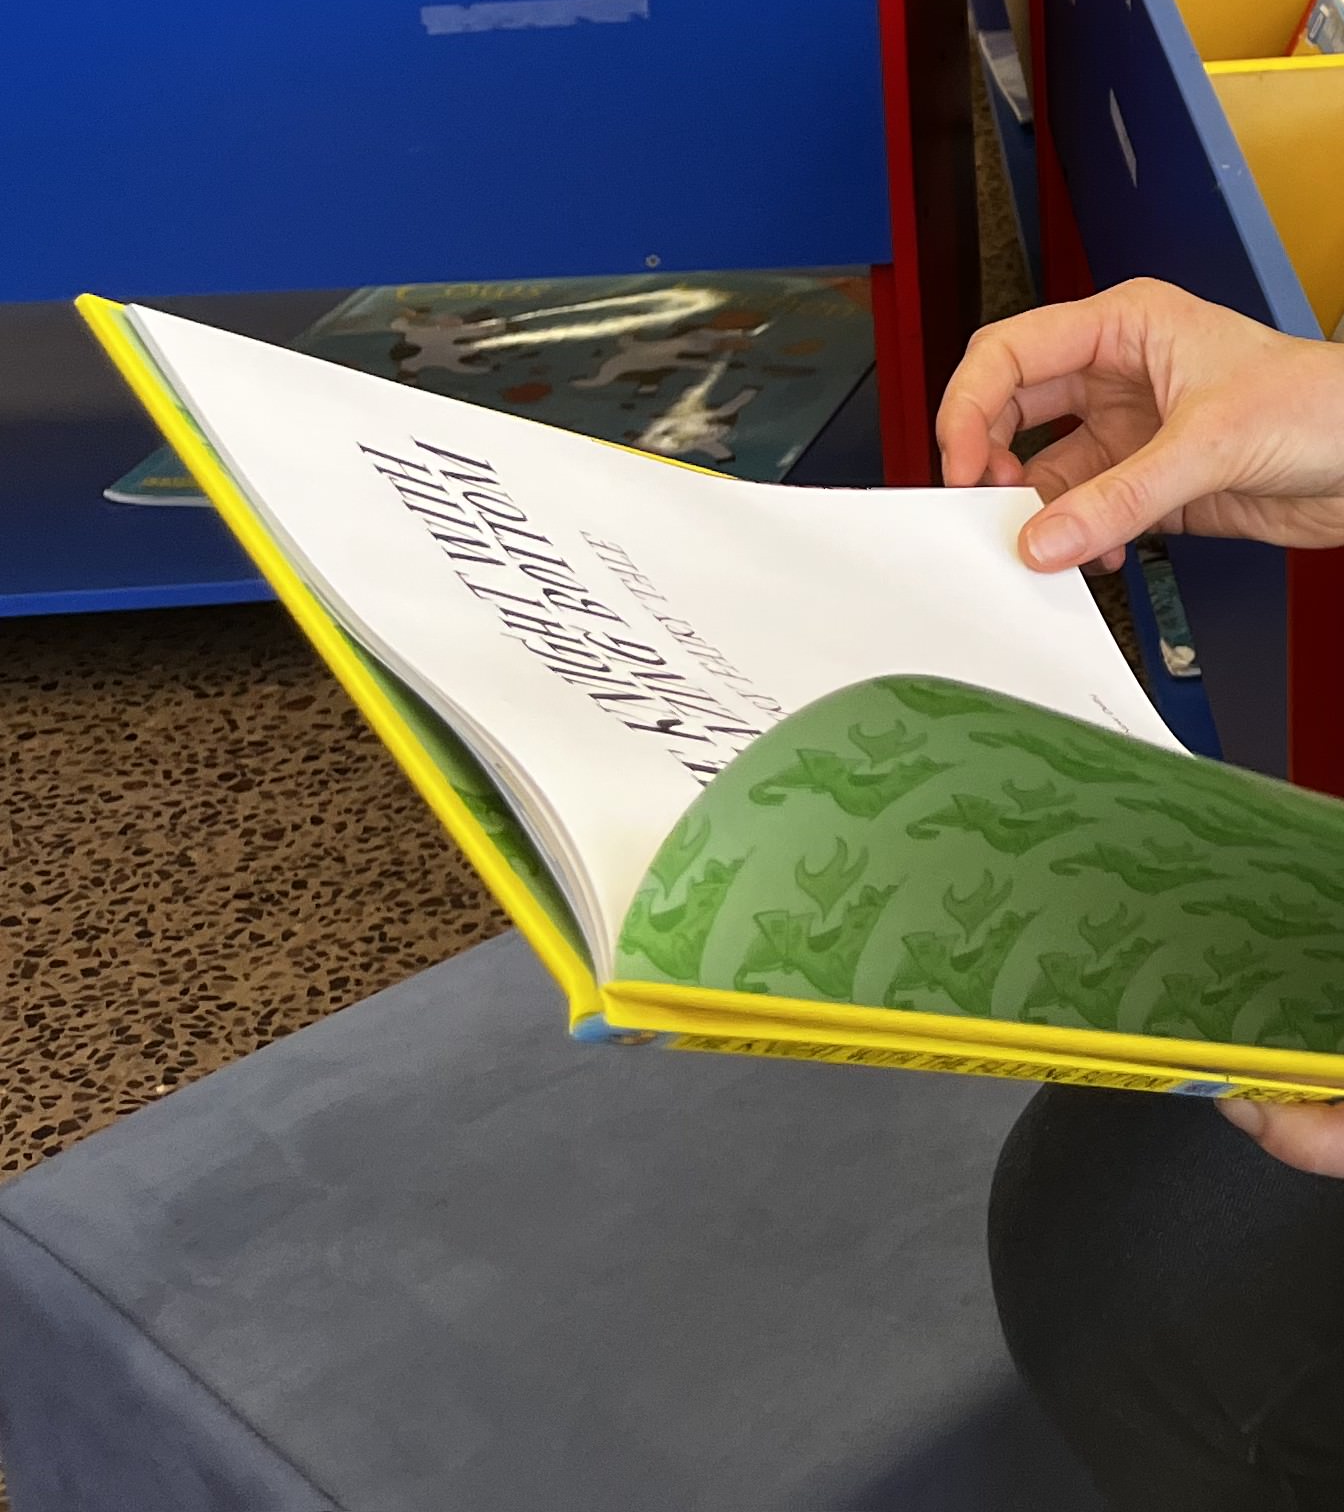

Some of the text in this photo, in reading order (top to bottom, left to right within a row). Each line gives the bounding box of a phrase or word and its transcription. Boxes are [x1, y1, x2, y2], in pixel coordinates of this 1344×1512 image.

[357, 441, 717, 746] KNIGHT WITH
[410, 434, 766, 754] AZING BOTTOM
[578, 529, 669, 602] TALE
[641, 603, 754, 684] FAIRY
